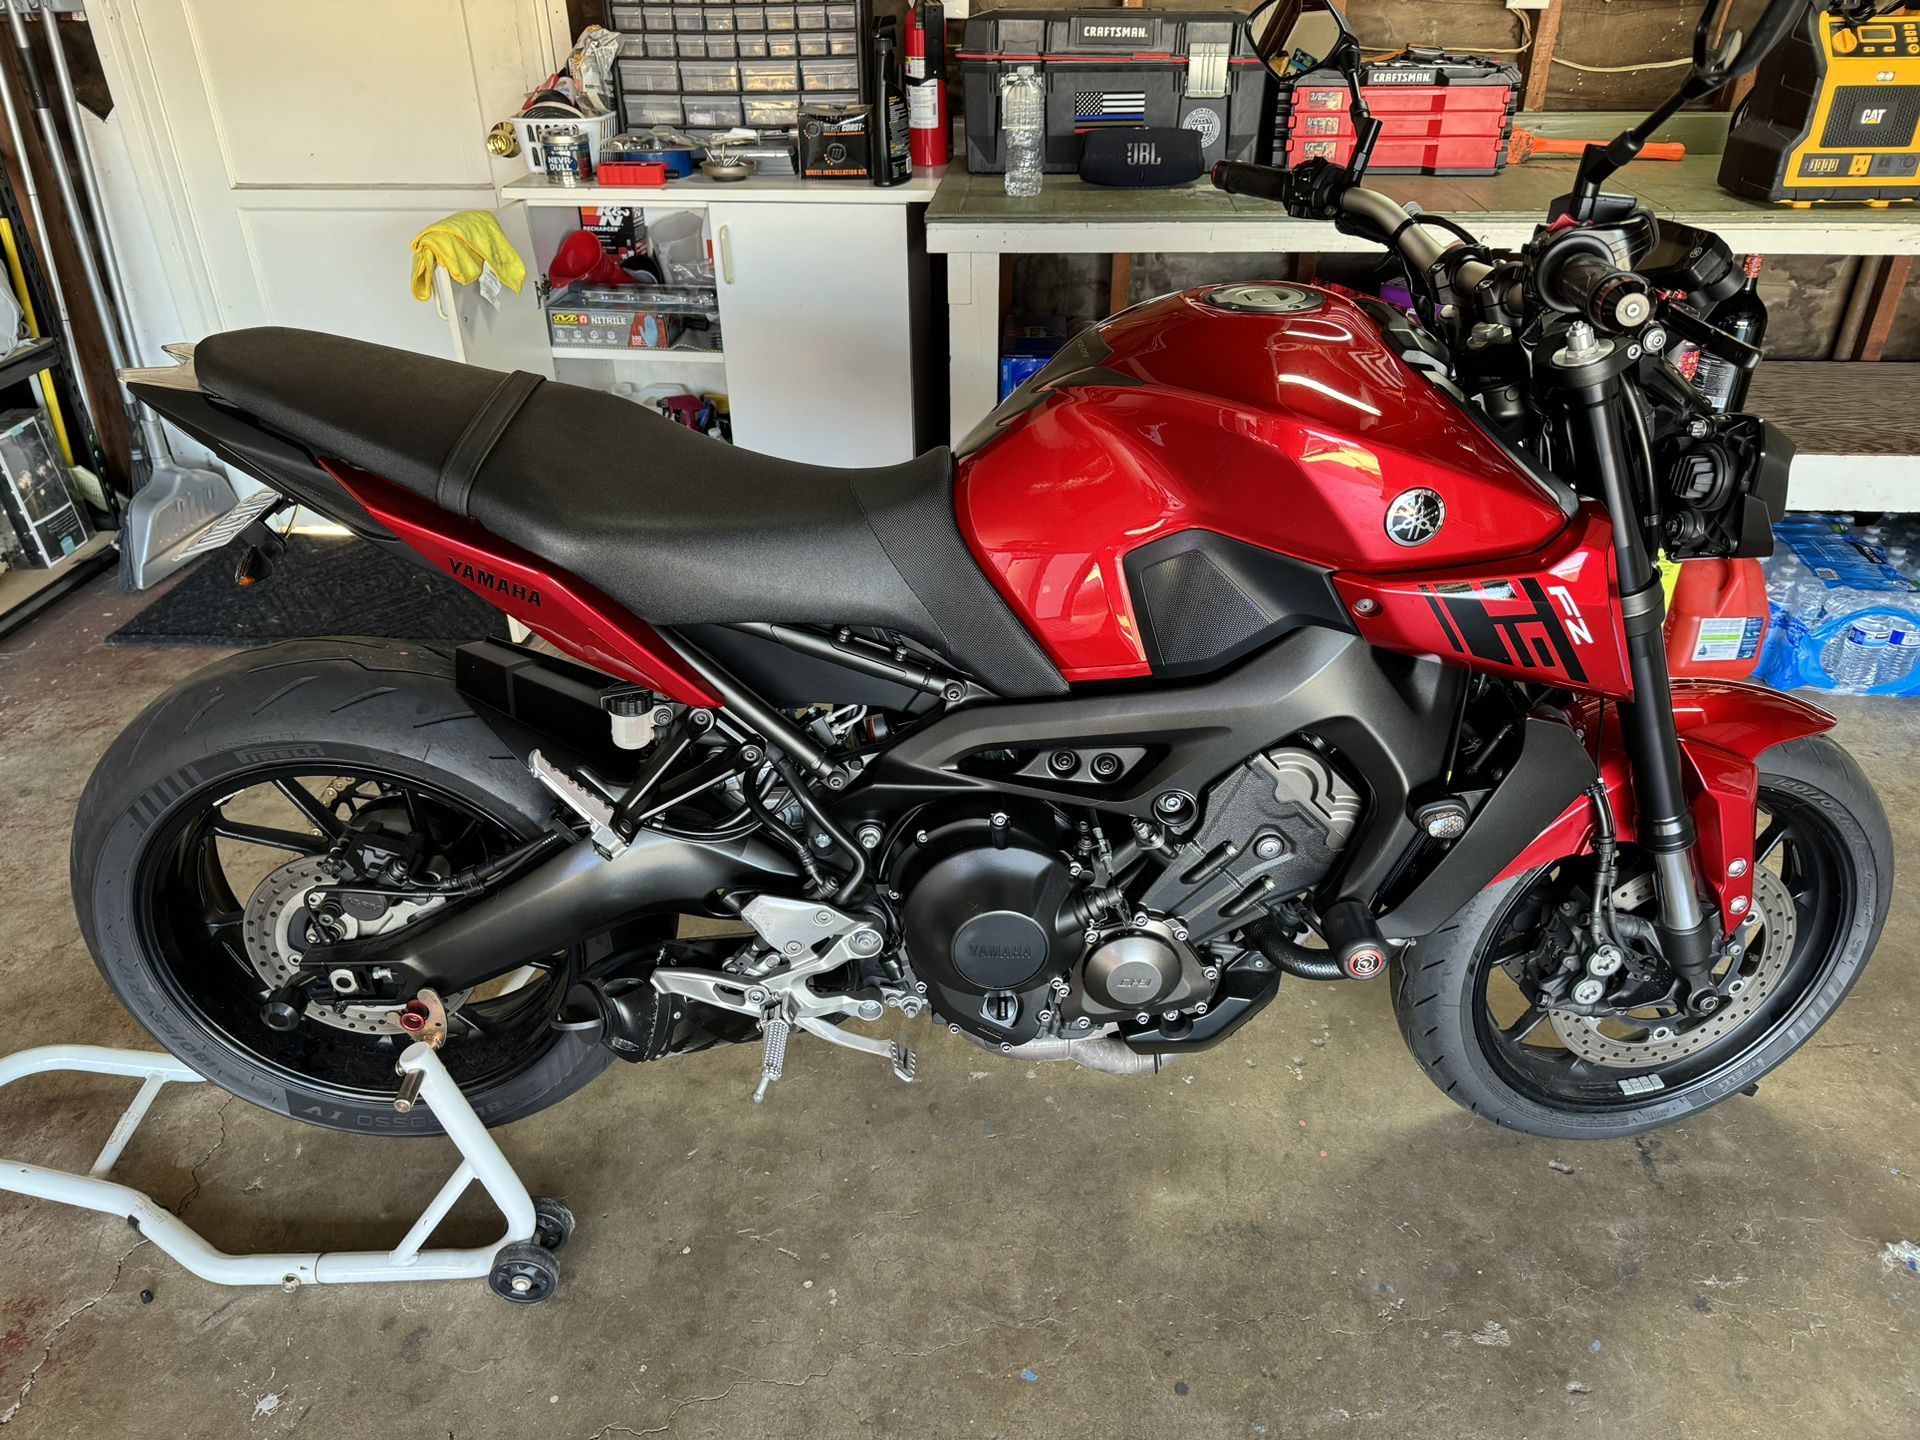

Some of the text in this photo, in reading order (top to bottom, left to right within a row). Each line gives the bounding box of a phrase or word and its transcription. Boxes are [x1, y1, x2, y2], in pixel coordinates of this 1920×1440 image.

[1084, 26, 1148, 38] CRAFTSMAN
[1373, 72, 1432, 83] CRAFTSMAN
[1860, 109, 1887, 125] CAT
[1190, 123, 1213, 132] YETI
[1126, 142, 1162, 166] JBL
[550, 163, 572, 171] DULL
[590, 315, 627, 326] NITRILE
[448, 556, 542, 607] YAMAHA
[1546, 585, 1594, 645] FZ
[233, 743, 327, 764] PIRELLI
[969, 943, 1032, 959] YAMAHA
[1718, 1057, 1767, 1091] PIRELLI
